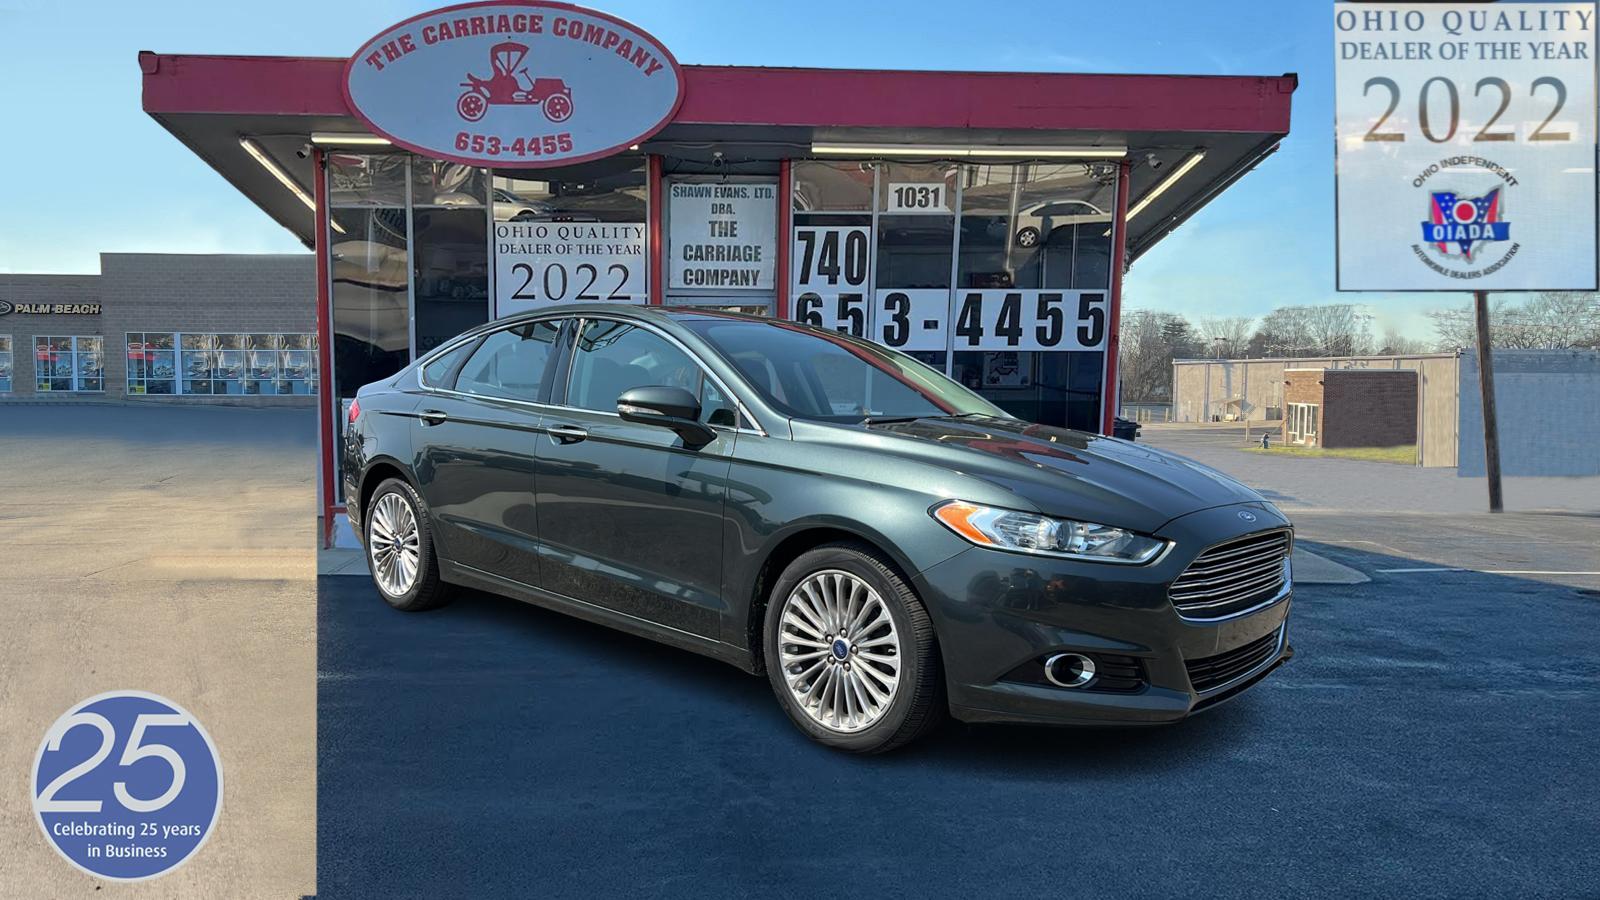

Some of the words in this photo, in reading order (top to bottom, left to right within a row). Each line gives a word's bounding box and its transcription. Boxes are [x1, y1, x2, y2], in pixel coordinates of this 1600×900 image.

[1336, 10, 1425, 32] OHIO
[1442, 10, 1593, 36] QUALITY
[366, 34, 416, 72] THE
[422, 14, 543, 45] CARRIAGE
[552, 17, 664, 77] COMPANY
[1340, 42, 1433, 61] DEALER
[1439, 42, 1470, 61] OF
[1475, 42, 1522, 60] THE
[1528, 42, 1589, 60] YEAR
[1362, 76, 1571, 144] 2022
[454, 132, 573, 157] 653-4455
[1412, 164, 1440, 189] OHIO
[1440, 155, 1519, 188] INDEPENDENT
[672, 186, 712, 199] SHAWN
[754, 185, 775, 199] LTD.
[894, 187, 940, 207] 1031
[711, 203, 736, 216] DBA.
[497, 226, 549, 239] OHIO
[557, 226, 645, 241] QUALITY
[708, 220, 738, 239] THE
[1432, 224, 1495, 240] OIADA
[499, 243, 552, 255] DEALER
[555, 243, 574, 255] OF
[576, 243, 603, 255] THE
[606, 243, 642, 255] YEAR
[683, 244, 762, 263] CARRIAGE
[797, 230, 868, 286] 740
[511, 262, 632, 301] 2022
[683, 268, 760, 287] COMPANY
[14, 304, 51, 314] PALM
[54, 304, 100, 314] BEACH
